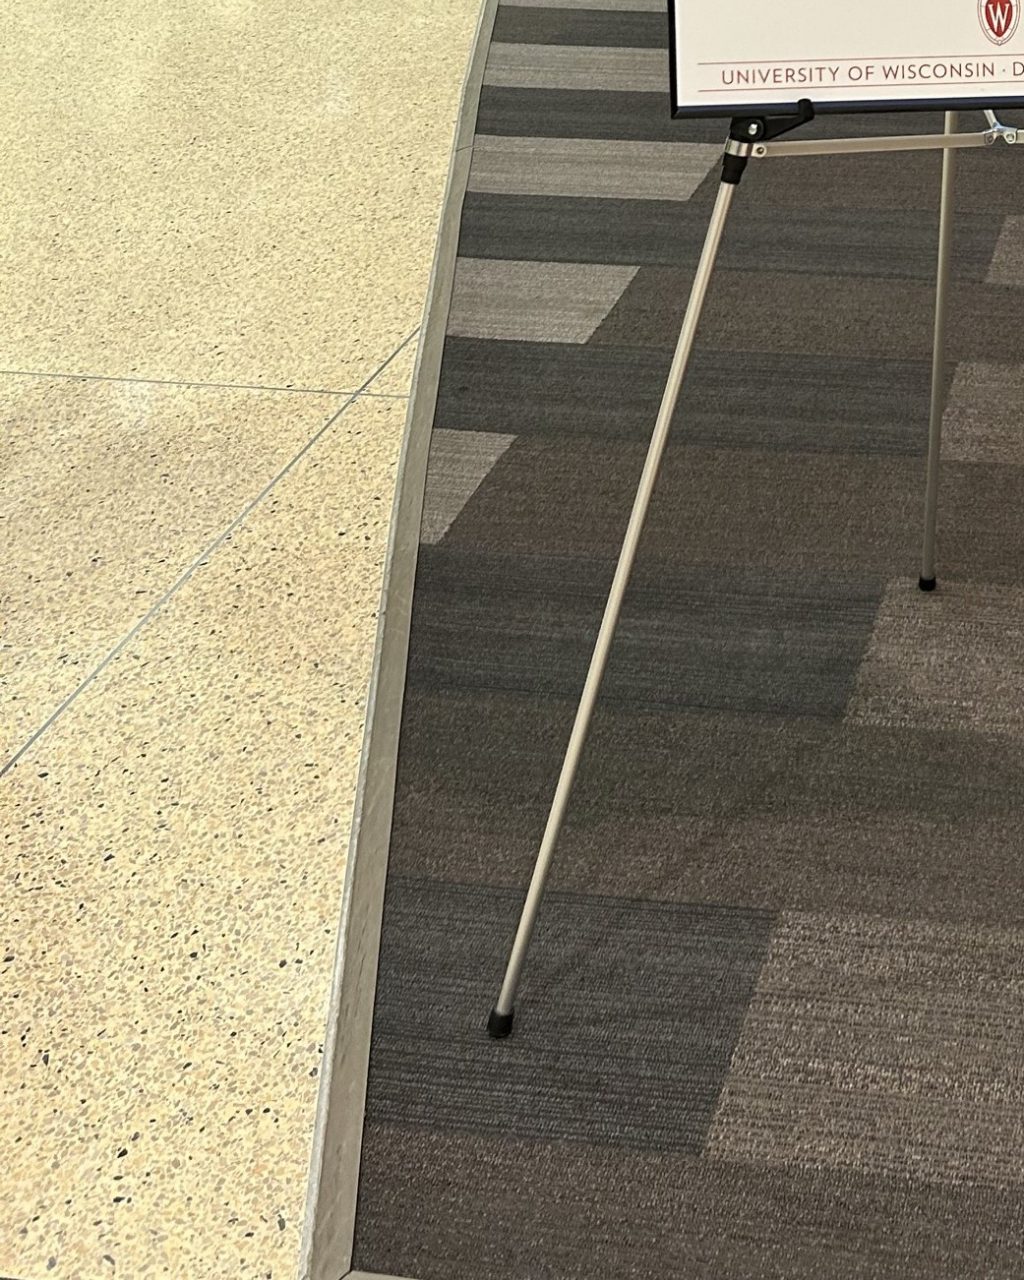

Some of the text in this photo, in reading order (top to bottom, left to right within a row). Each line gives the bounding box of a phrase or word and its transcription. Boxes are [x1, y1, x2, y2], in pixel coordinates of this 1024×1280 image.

[721, 66, 840, 87] UNIVERSITY
[847, 65, 876, 83] OF
[881, 61, 996, 83] WISCONSIN
